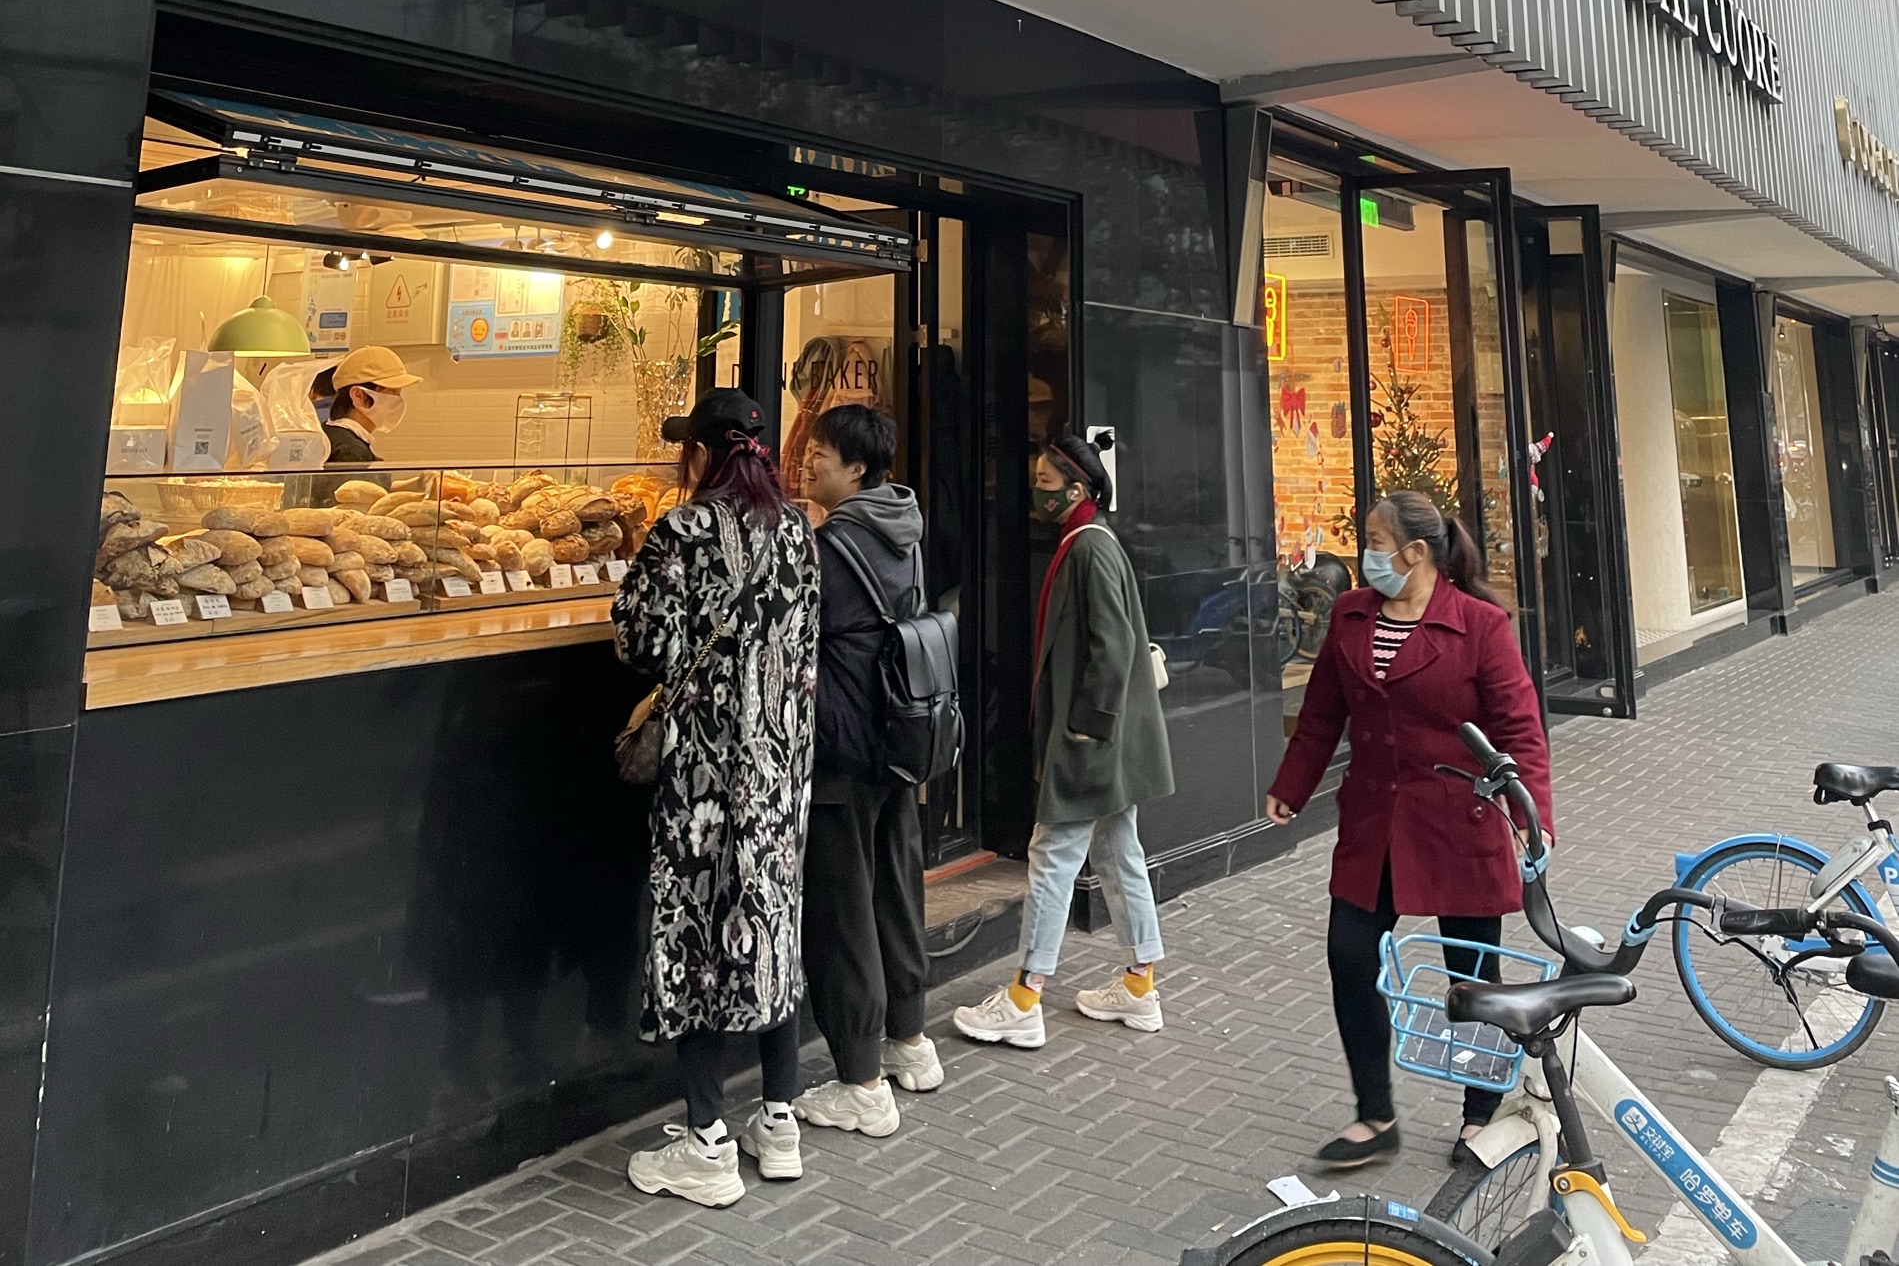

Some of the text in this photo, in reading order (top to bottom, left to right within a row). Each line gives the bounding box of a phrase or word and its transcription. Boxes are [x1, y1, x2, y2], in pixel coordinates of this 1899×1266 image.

[810, 359, 878, 390] BAKER
[1639, 1135, 1667, 1163] ALIPAY
[1679, 1167, 1748, 1241] 哈罗单车
